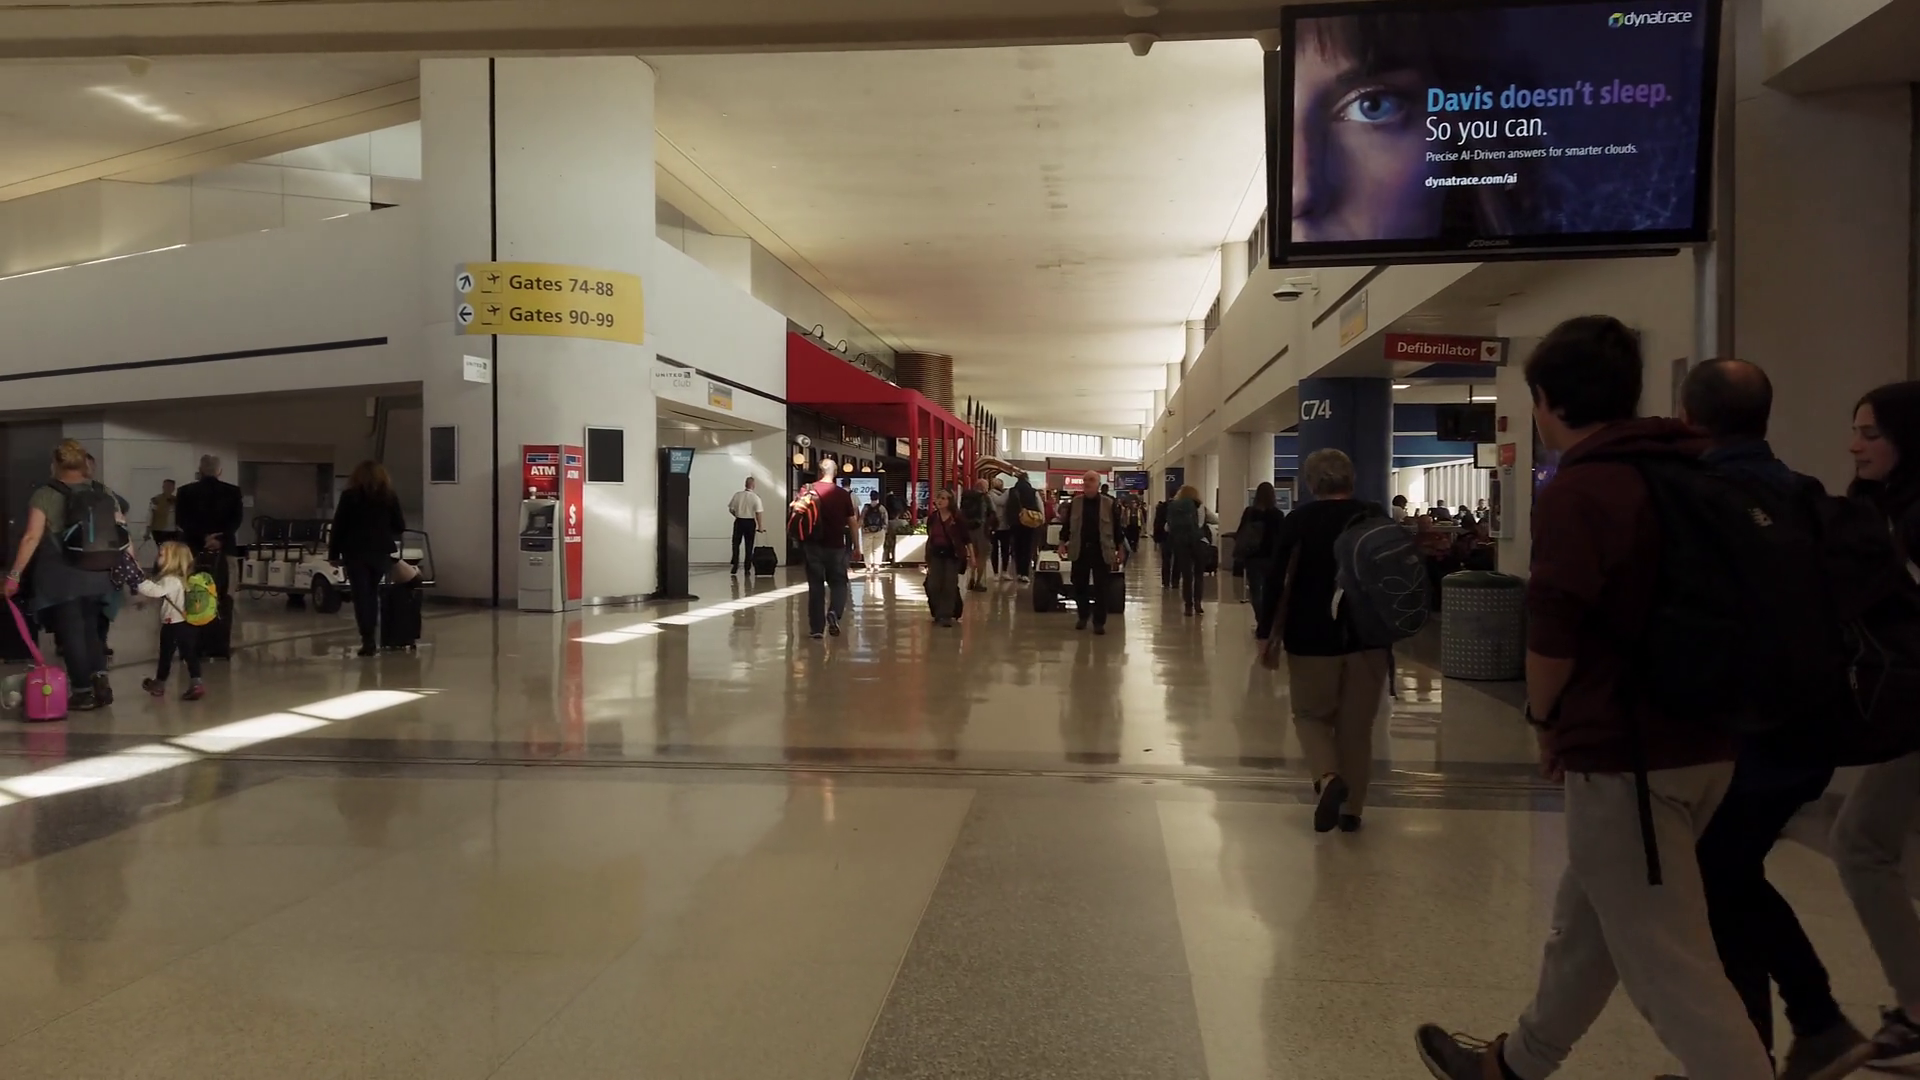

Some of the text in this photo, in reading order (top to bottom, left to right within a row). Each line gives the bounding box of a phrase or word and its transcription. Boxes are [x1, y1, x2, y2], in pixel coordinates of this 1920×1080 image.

[1624, 10, 1693, 28] dynatrace
[1427, 78, 1672, 112] Davis doesn’t sleep.
[1425, 116, 1548, 146] So you can.
[1426, 143, 1638, 162] Precise AI-Driven answers for smarter clouds.
[1425, 172, 1518, 189] dynatrace.com/ai
[509, 274, 614, 297] Gates 74-88
[509, 306, 614, 328] Gates 90-99
[1397, 341, 1477, 356] Defibrillator
[673, 379, 691, 387] Club
[1301, 399, 1332, 421] C74
[530, 465, 556, 476] ATM
[566, 469, 579, 479] ATM
